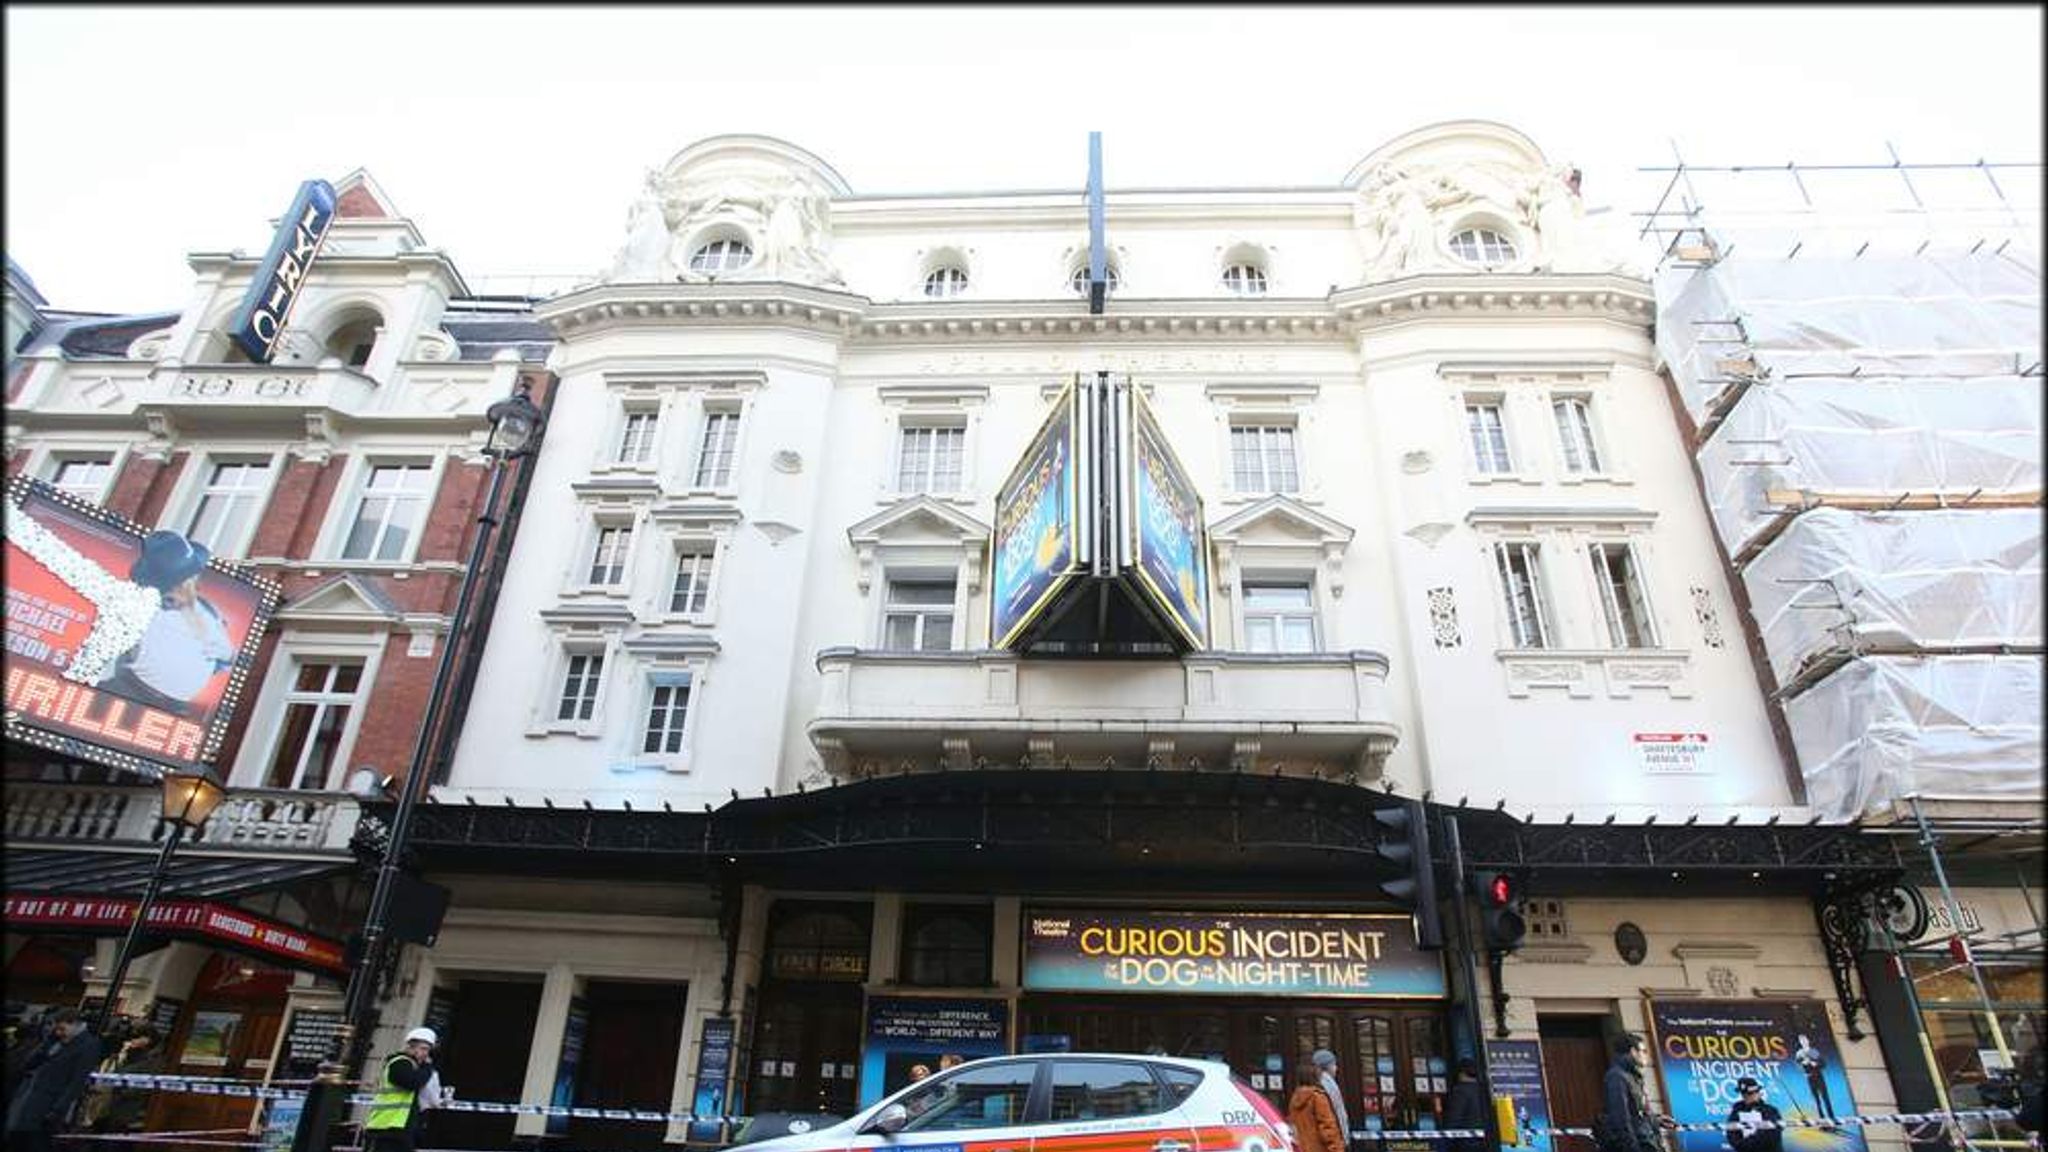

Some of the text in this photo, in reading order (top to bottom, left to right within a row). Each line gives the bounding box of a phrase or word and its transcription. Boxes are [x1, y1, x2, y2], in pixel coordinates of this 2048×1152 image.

[1080, 927, 1385, 962] CURIOUS INCIDENT
[1121, 957, 1199, 986] DOG
[1215, 960, 1371, 988] NIGHT-TIME
[885, 1026, 916, 1036] WORLD
[929, 1027, 976, 1039] DIFFERENT
[1665, 1034, 1789, 1060] CURIOUS
[1690, 1060, 1782, 1079] INCIDENT
